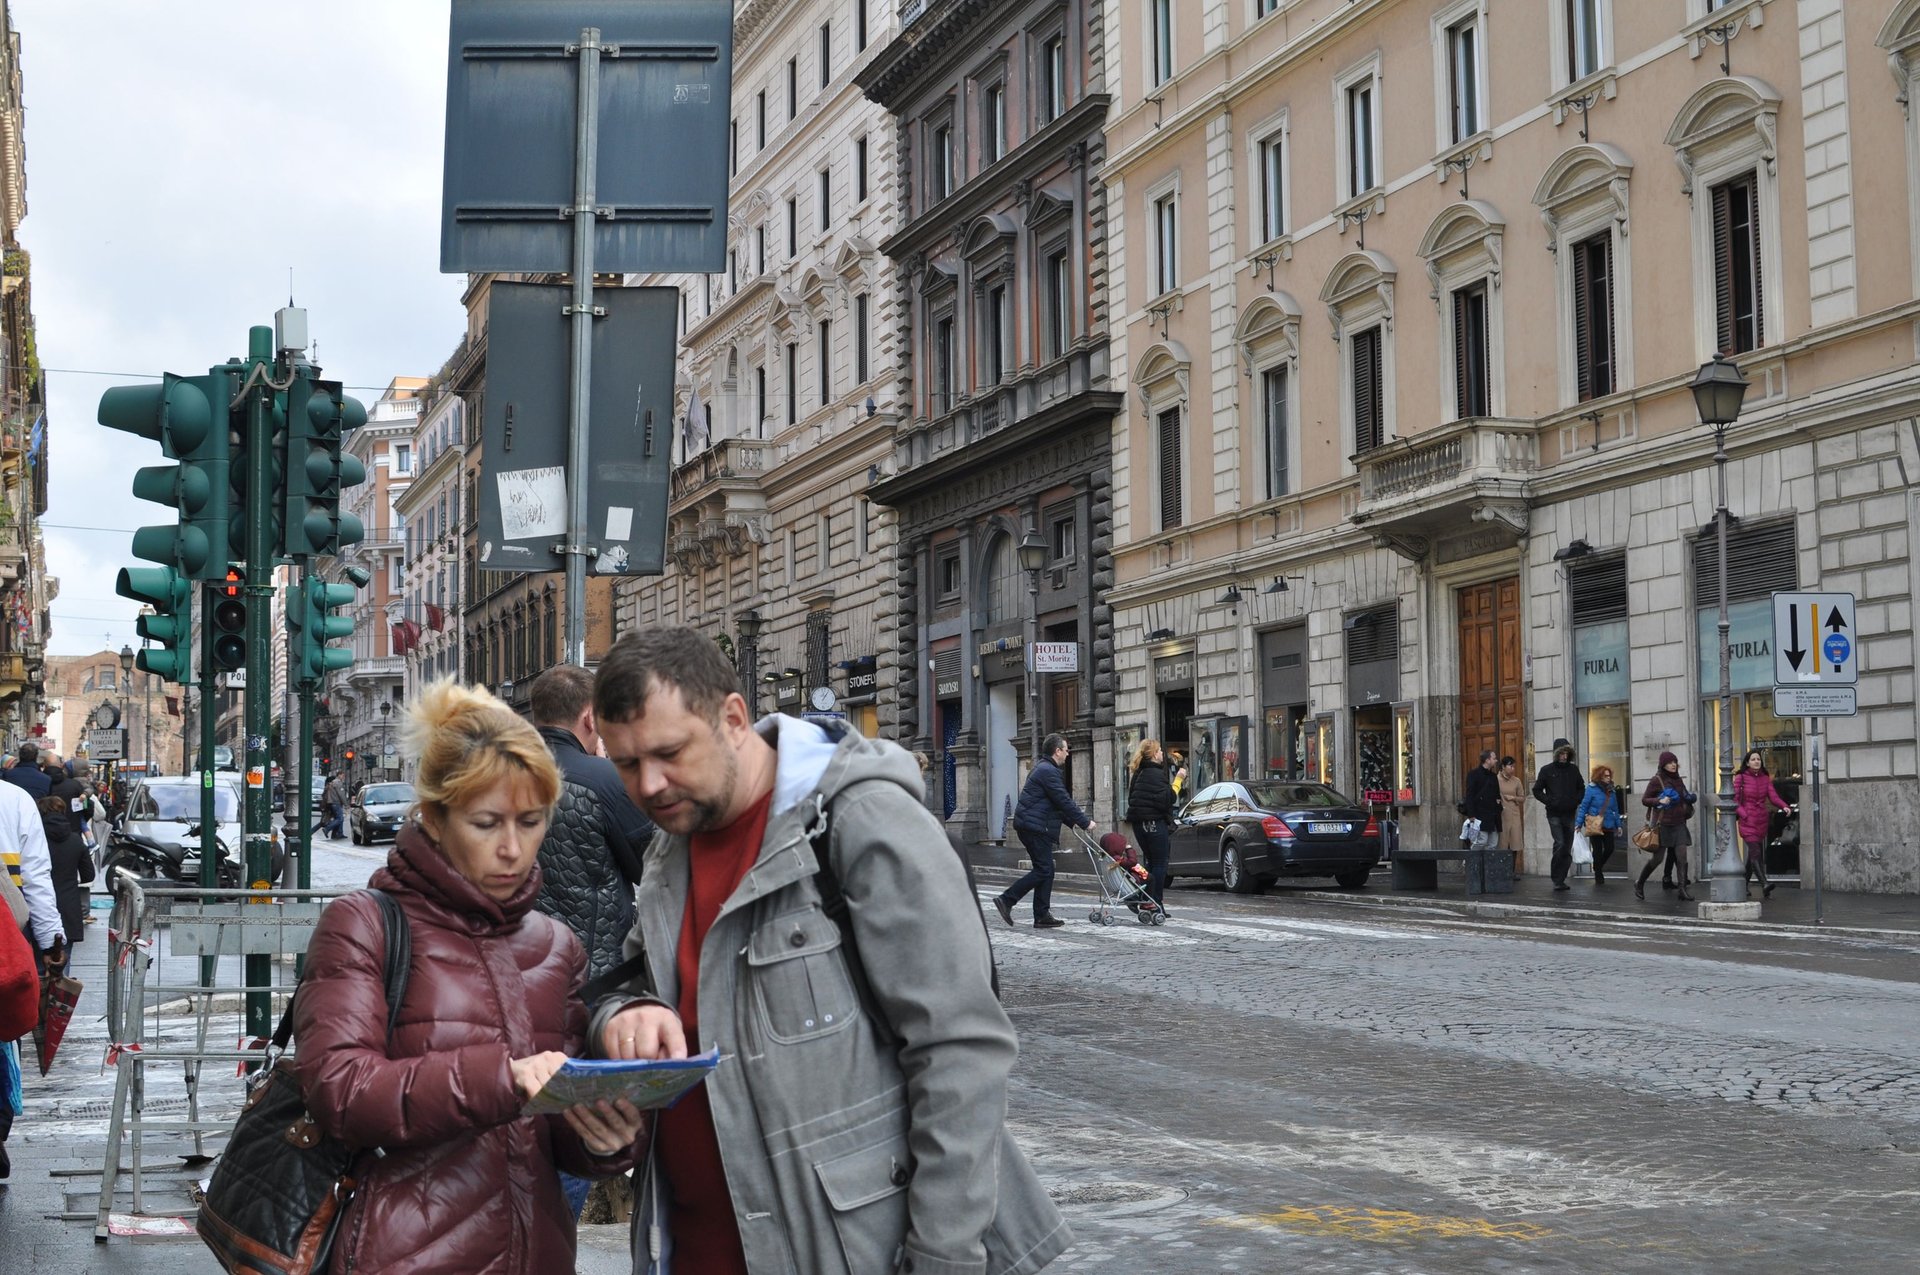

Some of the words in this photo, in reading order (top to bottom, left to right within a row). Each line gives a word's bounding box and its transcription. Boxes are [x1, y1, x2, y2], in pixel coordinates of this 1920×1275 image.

[1036, 645, 1072, 654] HOTEL
[1729, 640, 1770, 660] FURLA
[1048, 655, 1071, 663] Moritz
[1584, 657, 1620, 675] FURLA
[849, 673, 876, 688] STONEFLY
